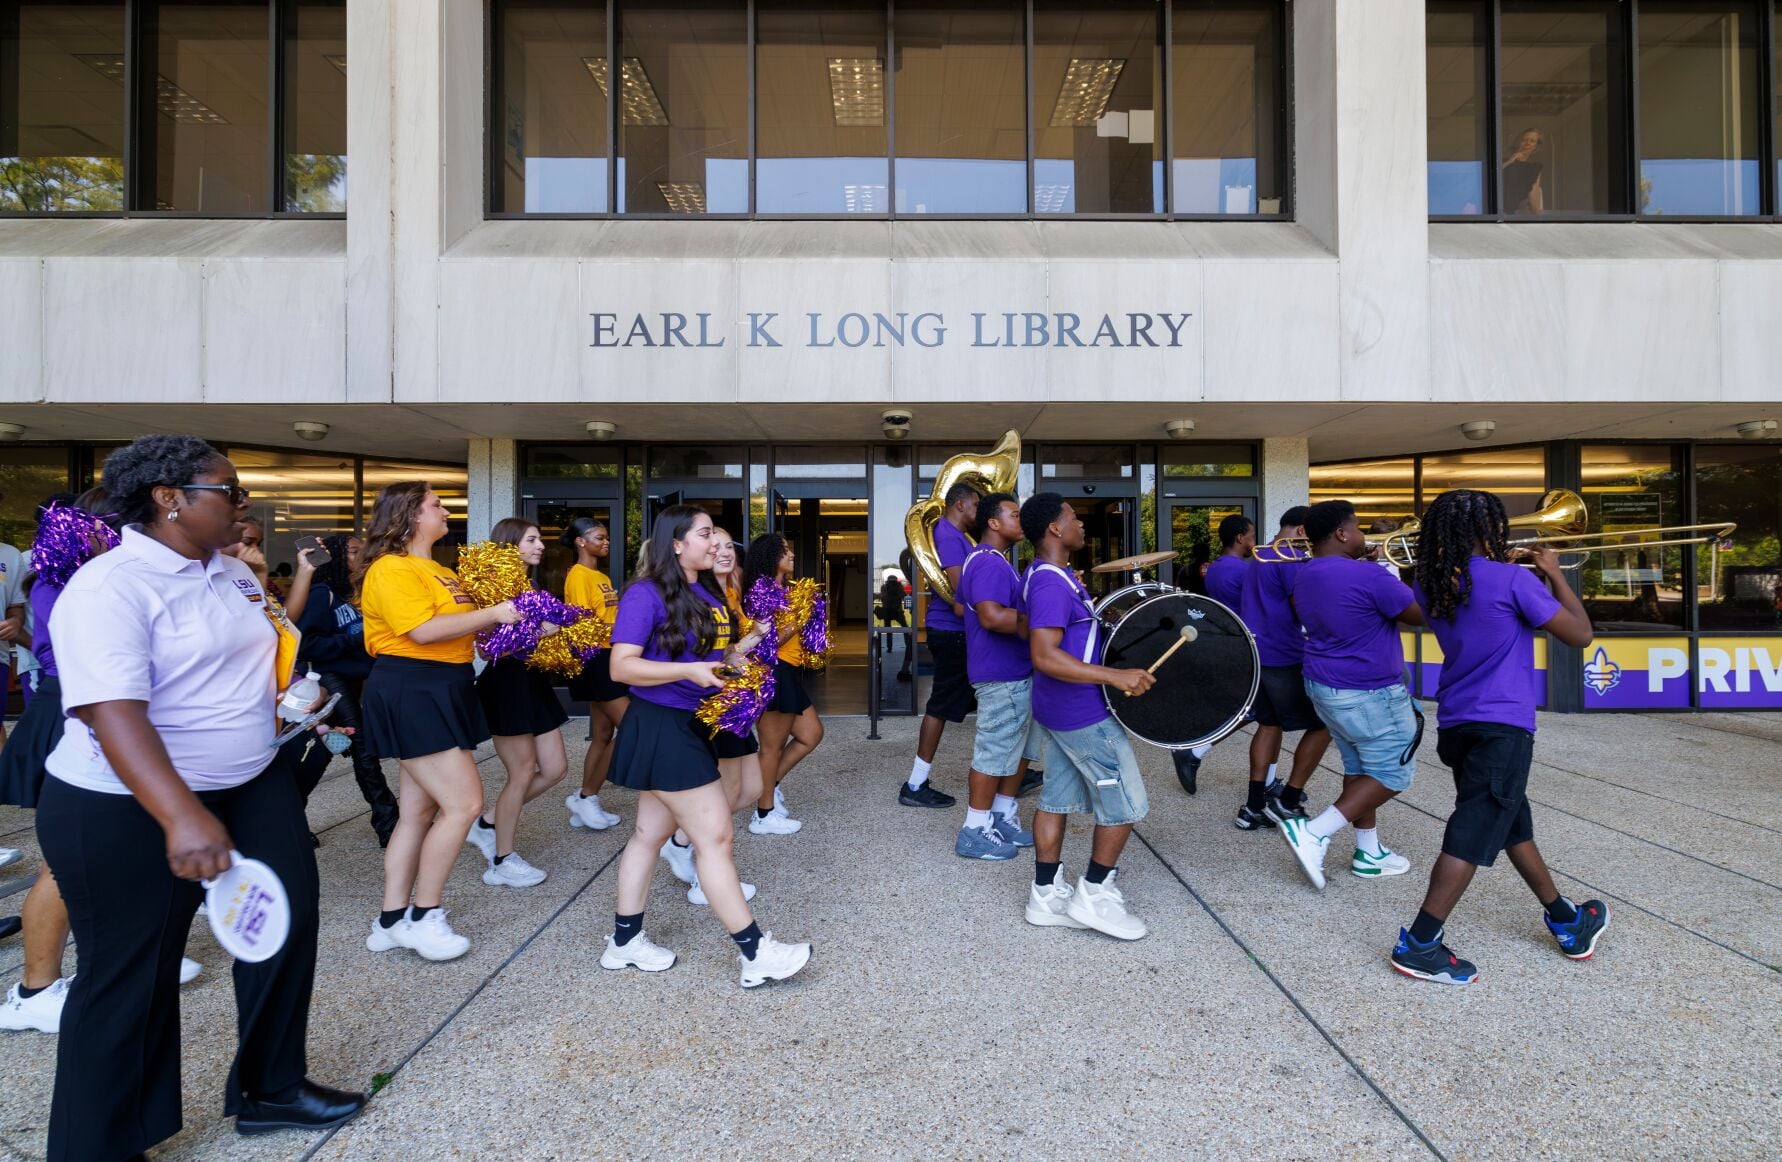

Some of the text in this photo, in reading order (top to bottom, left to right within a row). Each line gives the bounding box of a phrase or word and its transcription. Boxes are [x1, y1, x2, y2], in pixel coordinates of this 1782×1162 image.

[589, 312, 1193, 347] EARL K LONG LIBRARY
[232, 578, 255, 590] LSU
[334, 603, 358, 627] NEW
[1648, 648, 1782, 692] PRIV
